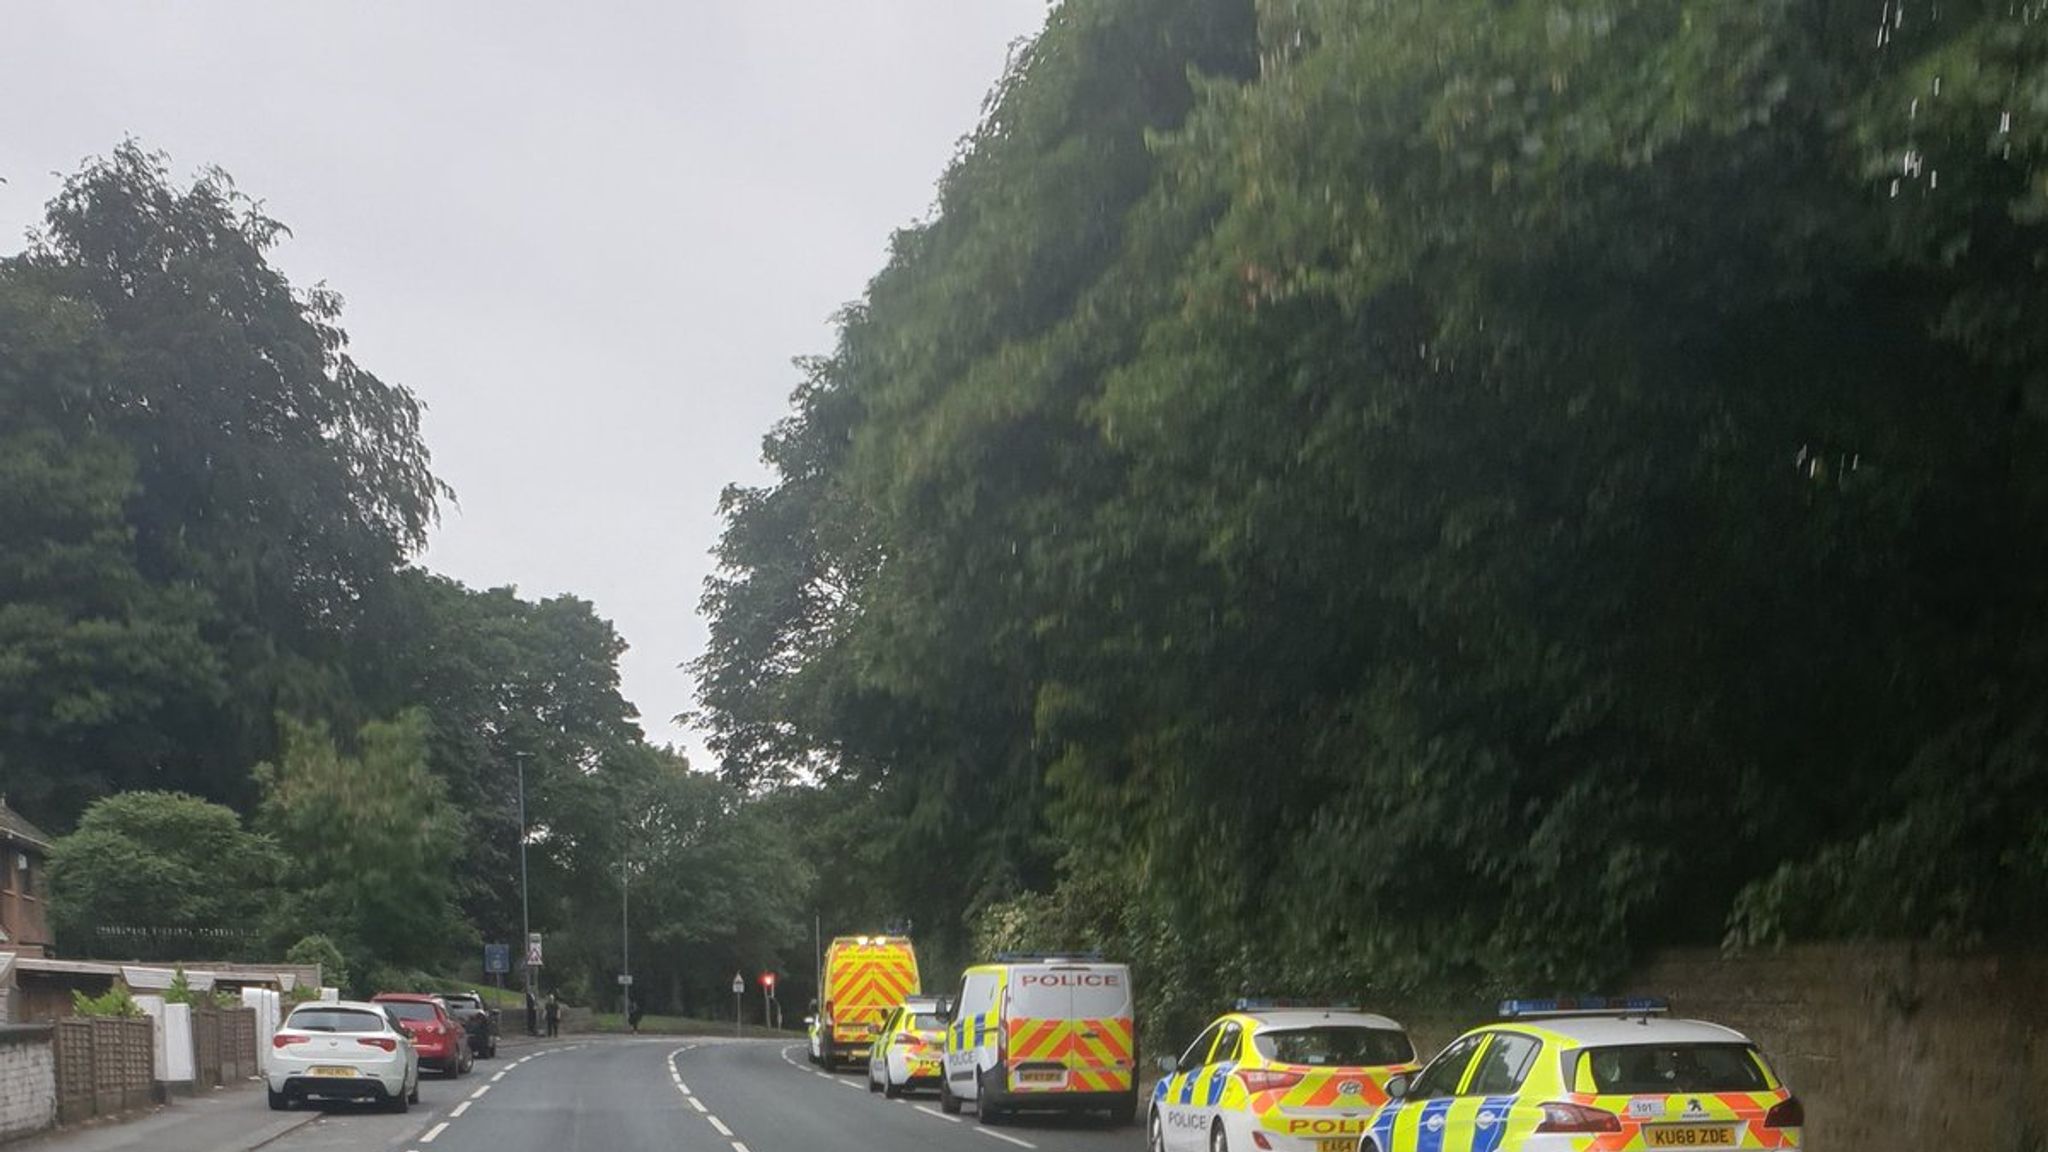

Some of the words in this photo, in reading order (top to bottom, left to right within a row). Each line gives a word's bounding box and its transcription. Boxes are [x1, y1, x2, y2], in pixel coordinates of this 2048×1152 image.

[1021, 974, 1119, 985] POLICE
[1168, 1111, 1207, 1129] POLICE
[1655, 1130, 1696, 1145] KU68
[1699, 1129, 1729, 1144] ZDE
